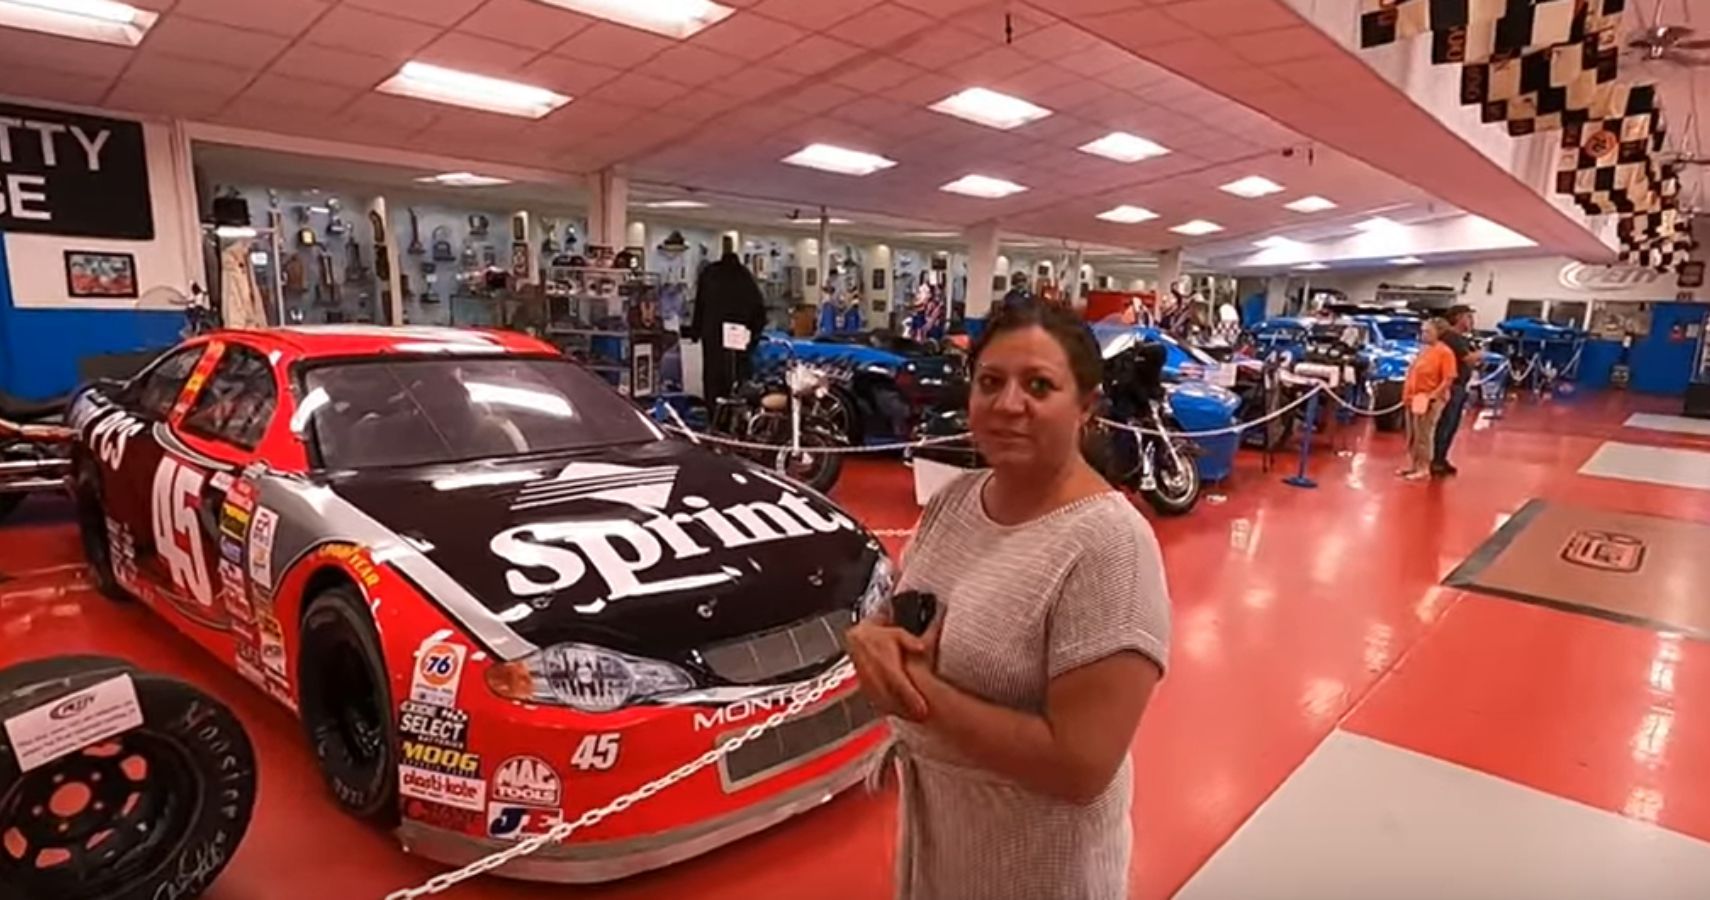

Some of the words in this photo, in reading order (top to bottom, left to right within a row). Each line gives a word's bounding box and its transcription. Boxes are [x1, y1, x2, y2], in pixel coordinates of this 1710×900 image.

[152, 455, 213, 607] 45
[489, 490, 847, 601] Sprint
[426, 655, 451, 675] 76
[400, 713, 464, 741] SELECT
[402, 740, 480, 772] MOOG
[570, 732, 621, 771] 45
[498, 758, 557, 790] MAC
